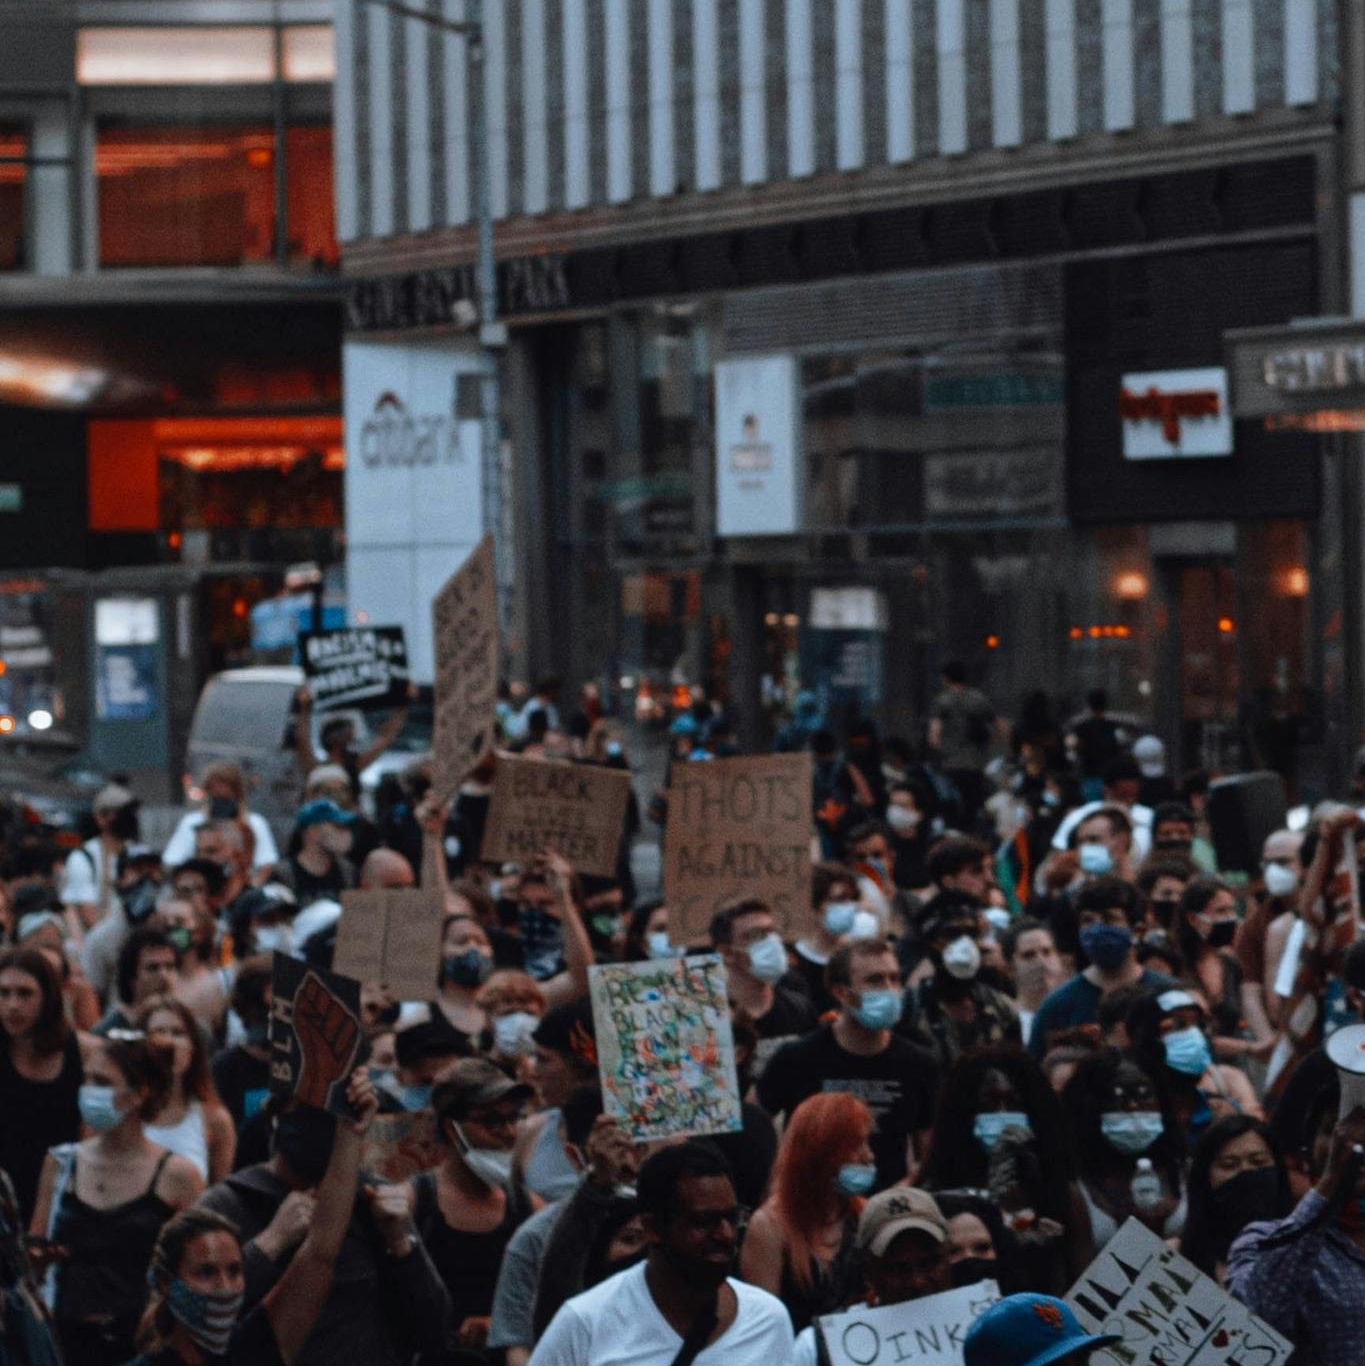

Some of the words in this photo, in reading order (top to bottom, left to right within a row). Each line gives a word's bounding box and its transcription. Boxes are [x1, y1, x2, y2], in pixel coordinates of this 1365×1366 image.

[514, 771, 594, 802] BLACK
[677, 841, 809, 887] AGAINST
[1073, 1252, 1154, 1322] ILL
[842, 1321, 966, 1366] OINK
